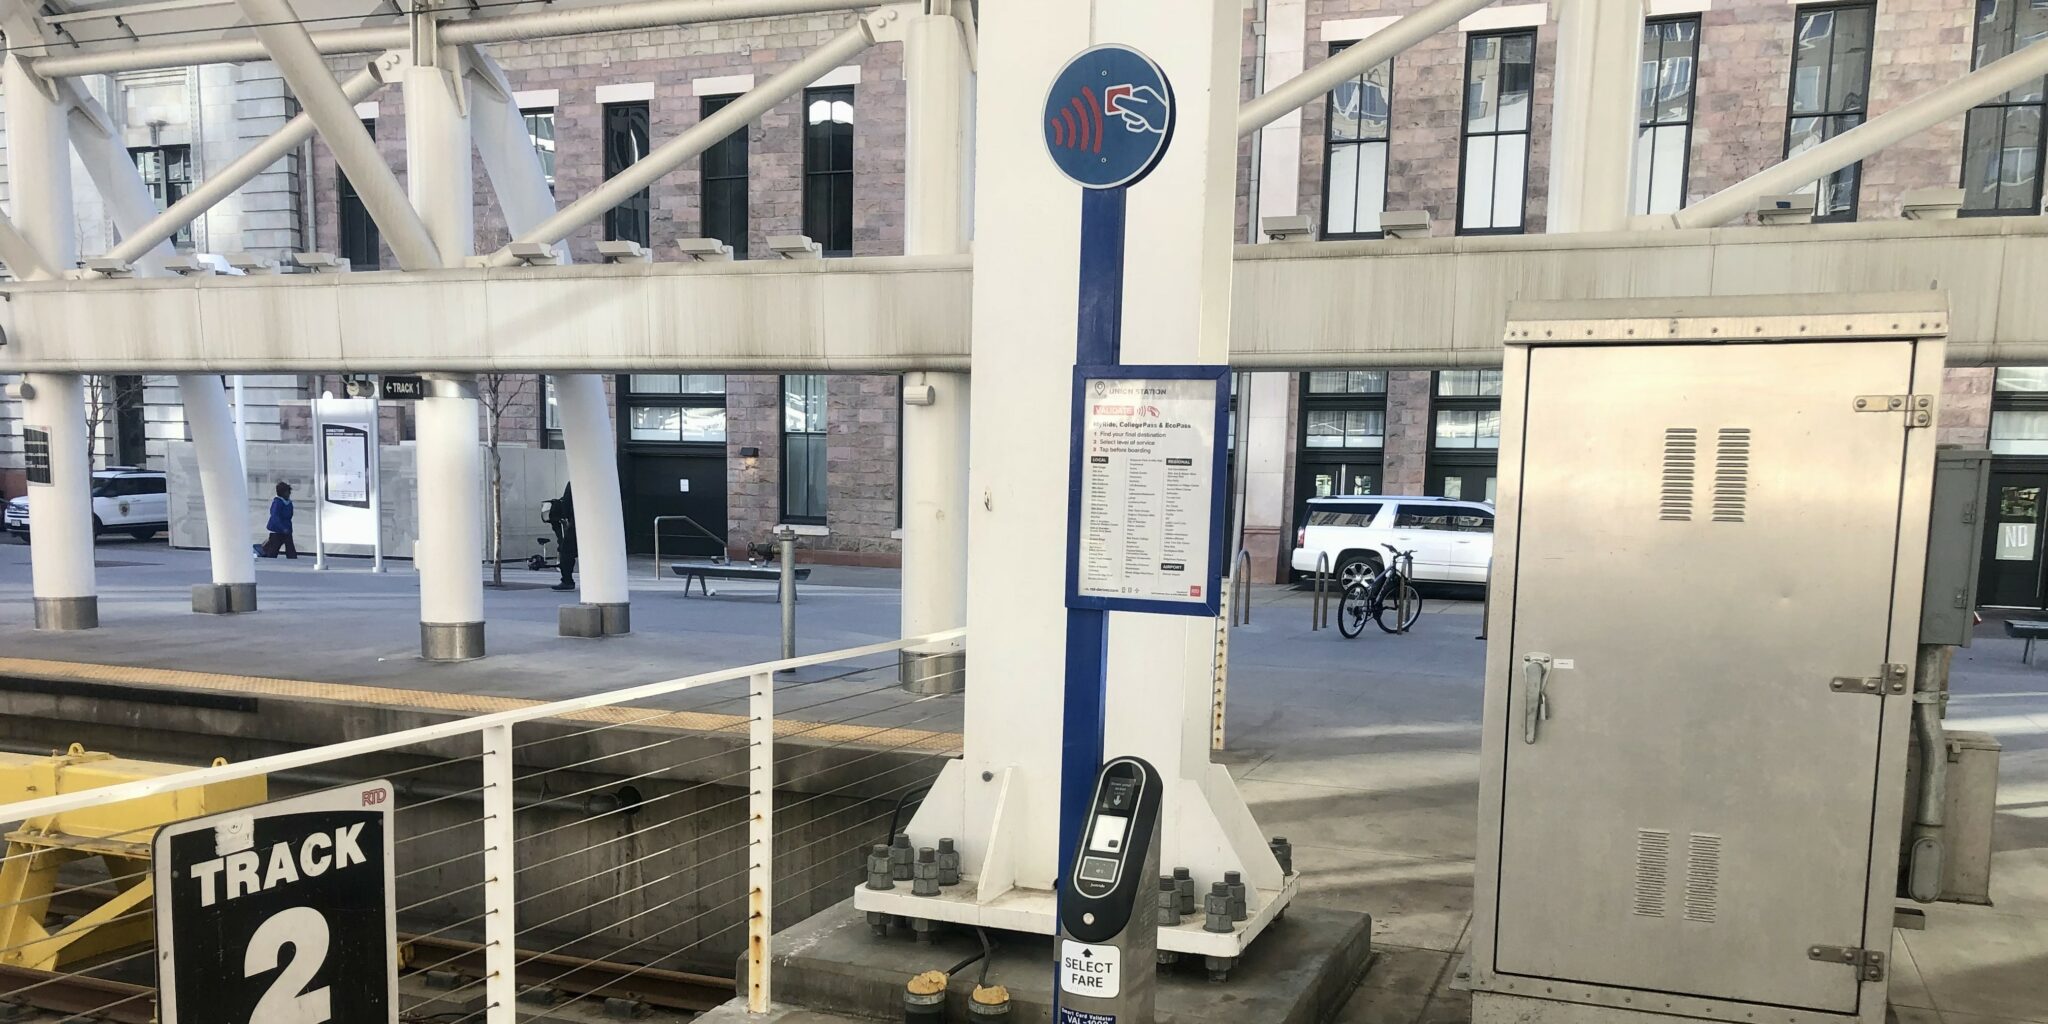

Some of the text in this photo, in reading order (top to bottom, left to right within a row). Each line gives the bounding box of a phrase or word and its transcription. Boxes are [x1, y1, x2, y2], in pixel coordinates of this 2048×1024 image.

[393, 381, 420, 395] TRACK 1
[361, 788, 387, 806] RTD
[190, 822, 367, 907] TRACK
[244, 906, 331, 1024] 2
[1065, 957, 1113, 974] SELECT
[1071, 973, 1104, 988] FARE
[1075, 1011, 1088, 1019] Card
[1089, 1014, 1114, 1022] Validator
